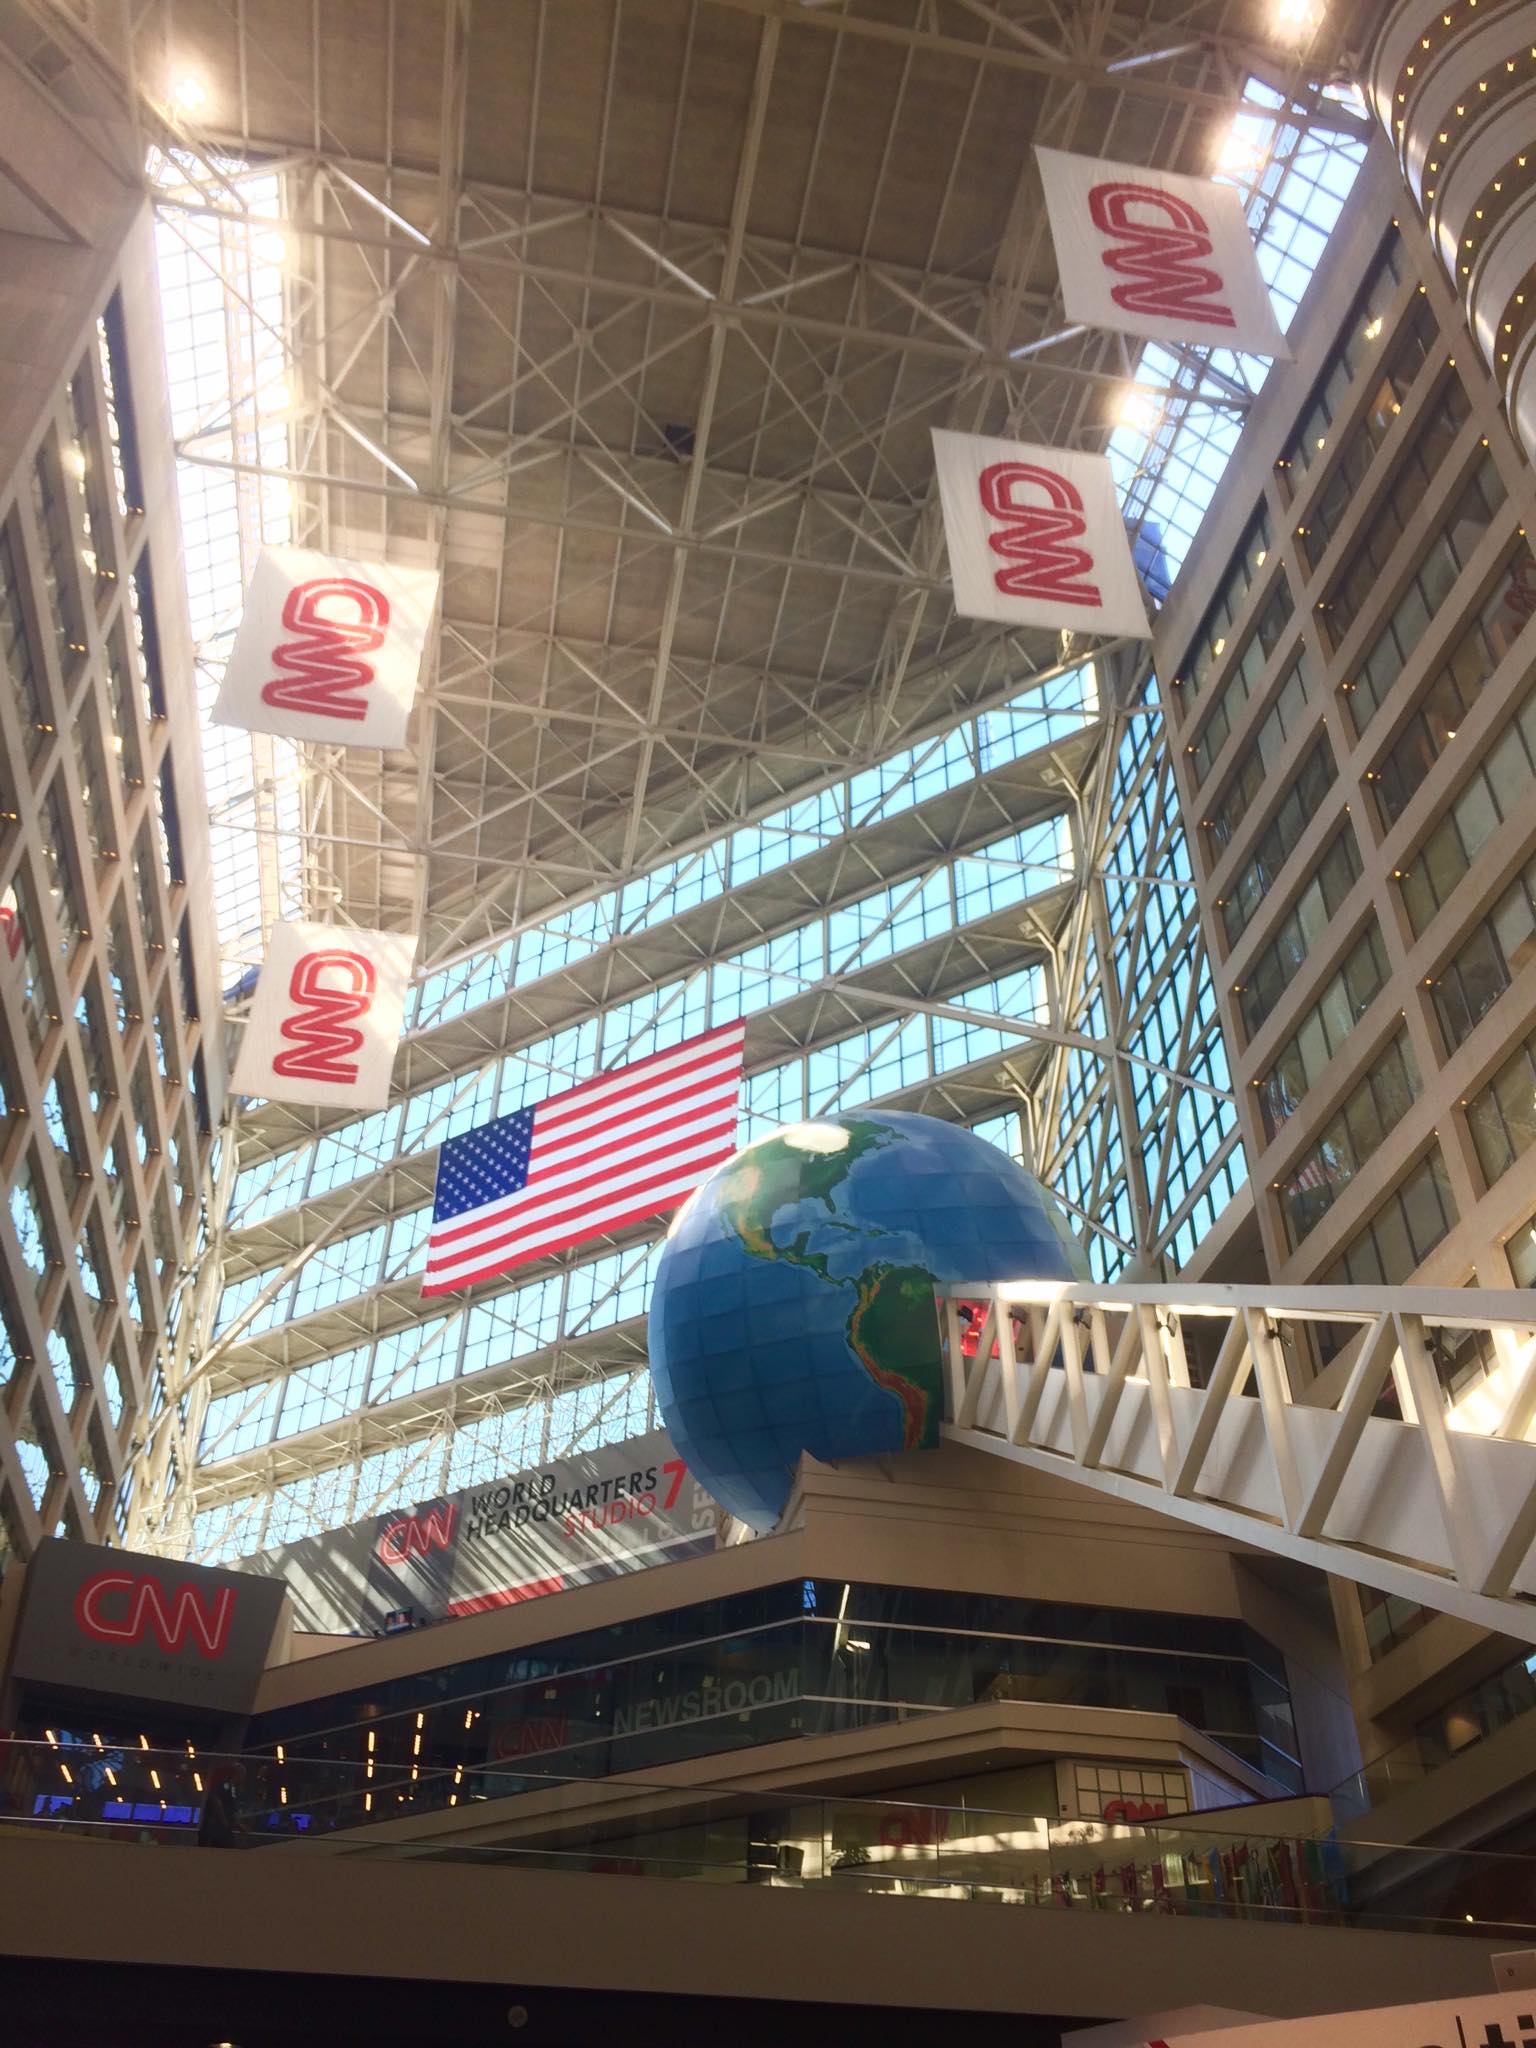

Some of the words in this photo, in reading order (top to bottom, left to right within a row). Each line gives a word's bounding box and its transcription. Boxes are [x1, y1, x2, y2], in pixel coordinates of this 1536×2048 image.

[1088, 181, 1238, 329] CNN
[979, 462, 1104, 609] CNN
[261, 577, 390, 721] CNN
[272, 948, 377, 1085] CNN
[379, 1503, 458, 1566] CNN
[466, 1467, 658, 1543] HEADQUARTERS
[471, 1473, 556, 1518] WORLD
[564, 1492, 657, 1539] STUDIO
[662, 1459, 687, 1509] 7
[75, 1569, 238, 1659] CNN
[615, 1670, 799, 1735] NEWSROOM
